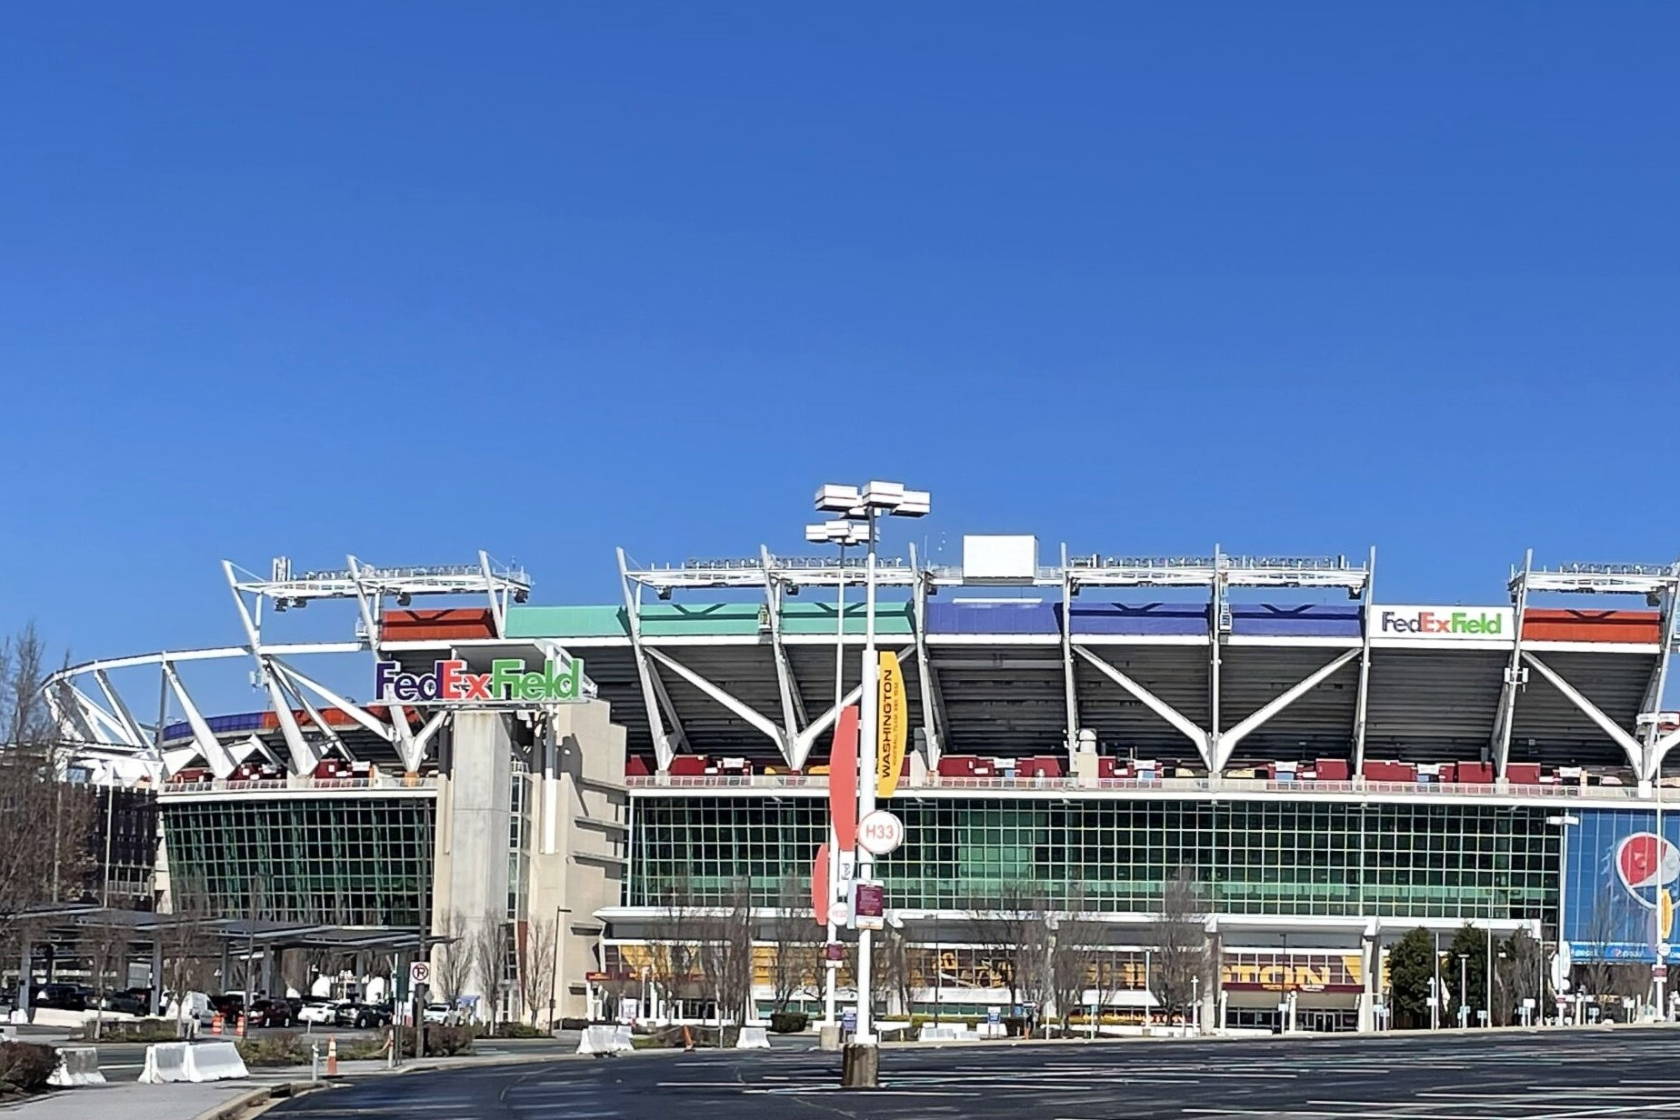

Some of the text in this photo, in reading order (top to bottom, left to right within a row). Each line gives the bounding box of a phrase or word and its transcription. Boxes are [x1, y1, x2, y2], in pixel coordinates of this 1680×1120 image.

[1382, 611, 1502, 634] FedExField
[376, 659, 582, 701] FedExField
[882, 669, 892, 778] WASHINGTON
[866, 825, 894, 839] H33
